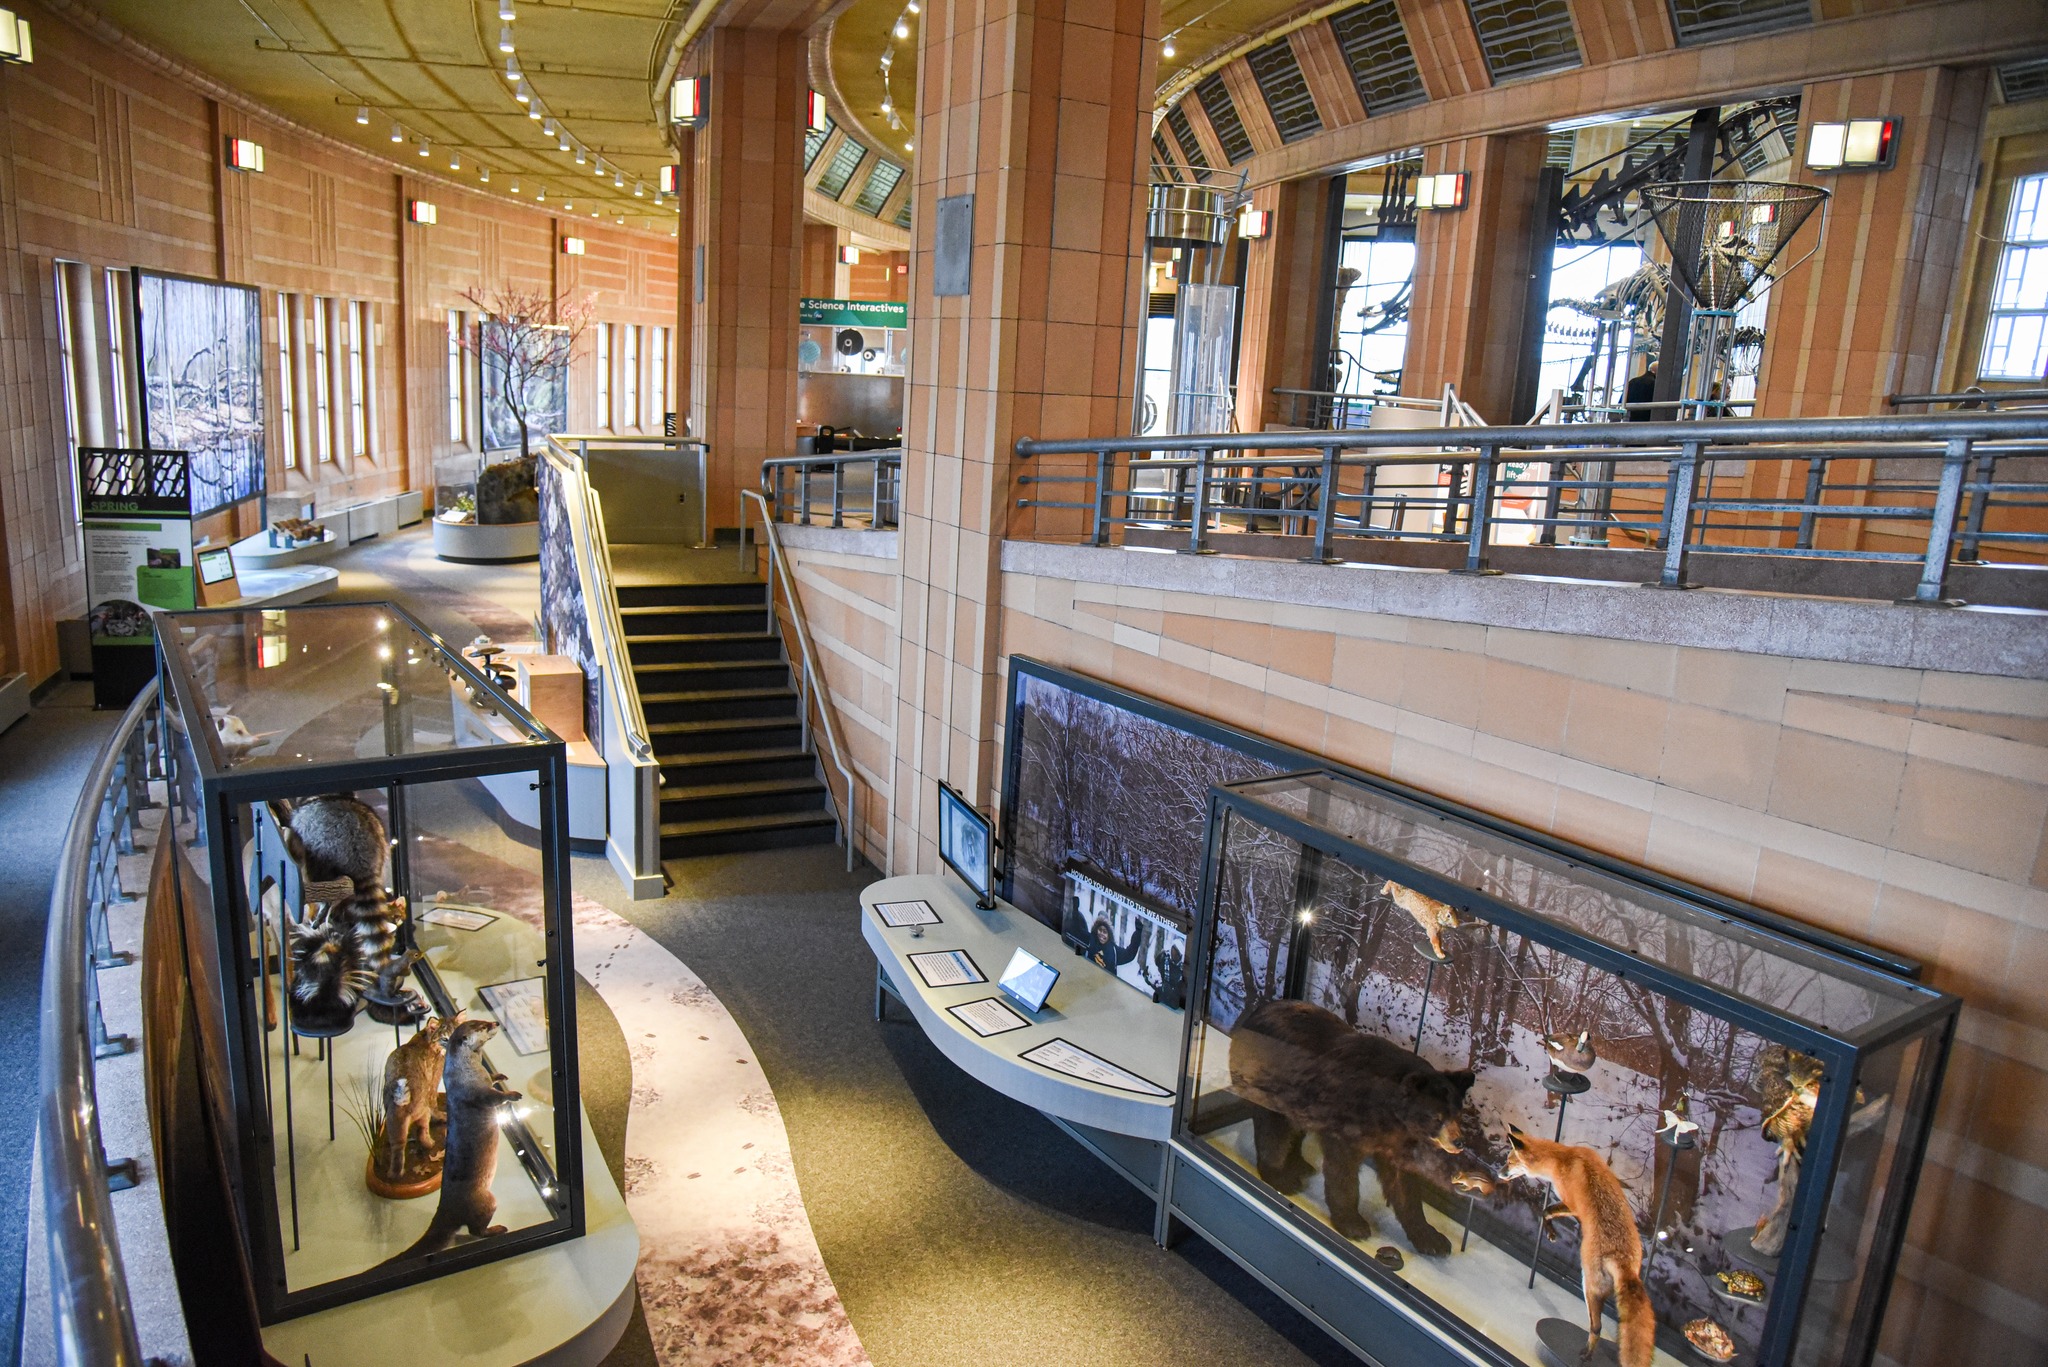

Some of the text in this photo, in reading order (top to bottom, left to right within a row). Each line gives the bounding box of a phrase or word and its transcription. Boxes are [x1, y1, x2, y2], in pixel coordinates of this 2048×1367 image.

[808, 300, 845, 311] Science
[847, 302, 904, 313] Interactives
[91, 501, 138, 511] SPRING
[1070, 869, 1084, 880] HOW
[1084, 875, 1093, 885] DO
[1093, 880, 1105, 892] YOU
[1126, 897, 1135, 908] TO
[1135, 902, 1147, 915] THE
[1146, 908, 1178, 929] WEATHER?
